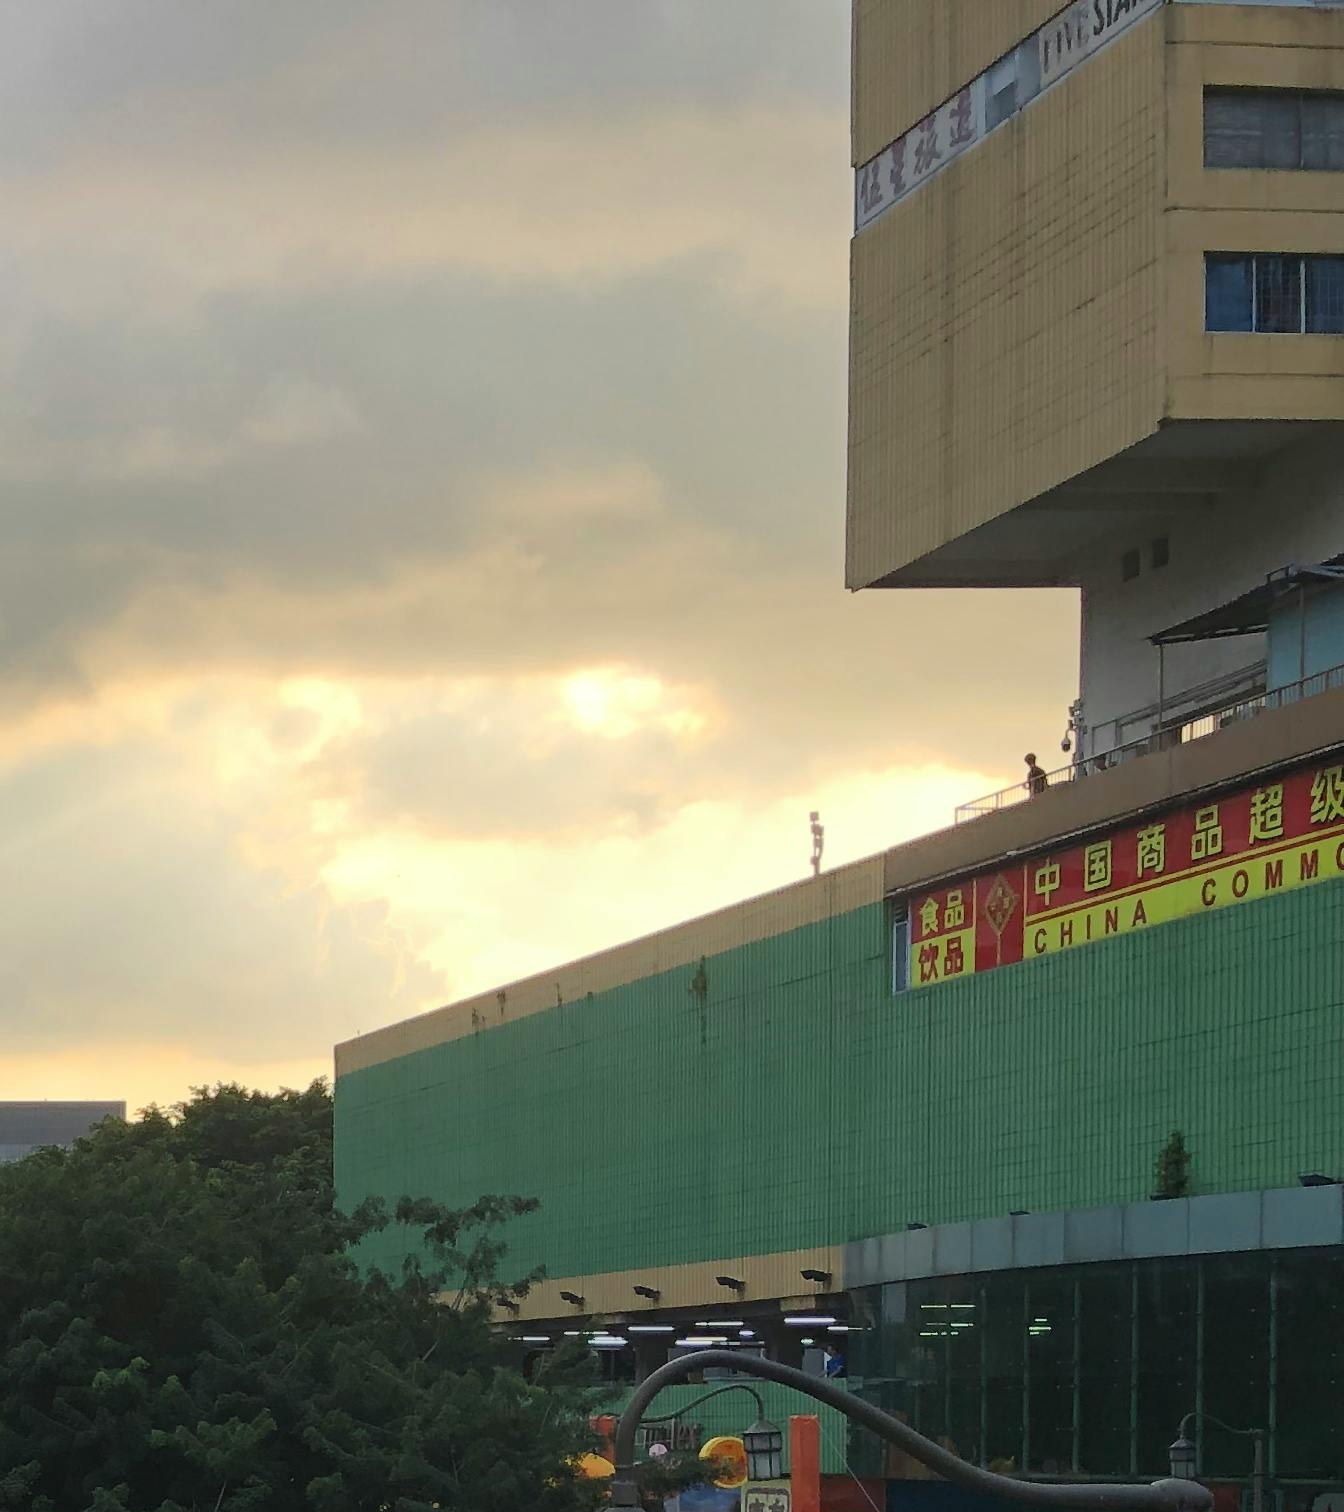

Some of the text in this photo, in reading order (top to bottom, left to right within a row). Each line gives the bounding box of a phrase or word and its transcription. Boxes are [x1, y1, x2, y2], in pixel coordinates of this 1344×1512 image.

[919, 889, 965, 937] 食品
[1034, 898, 1147, 954] CHINA
[918, 936, 964, 983] 饮品
